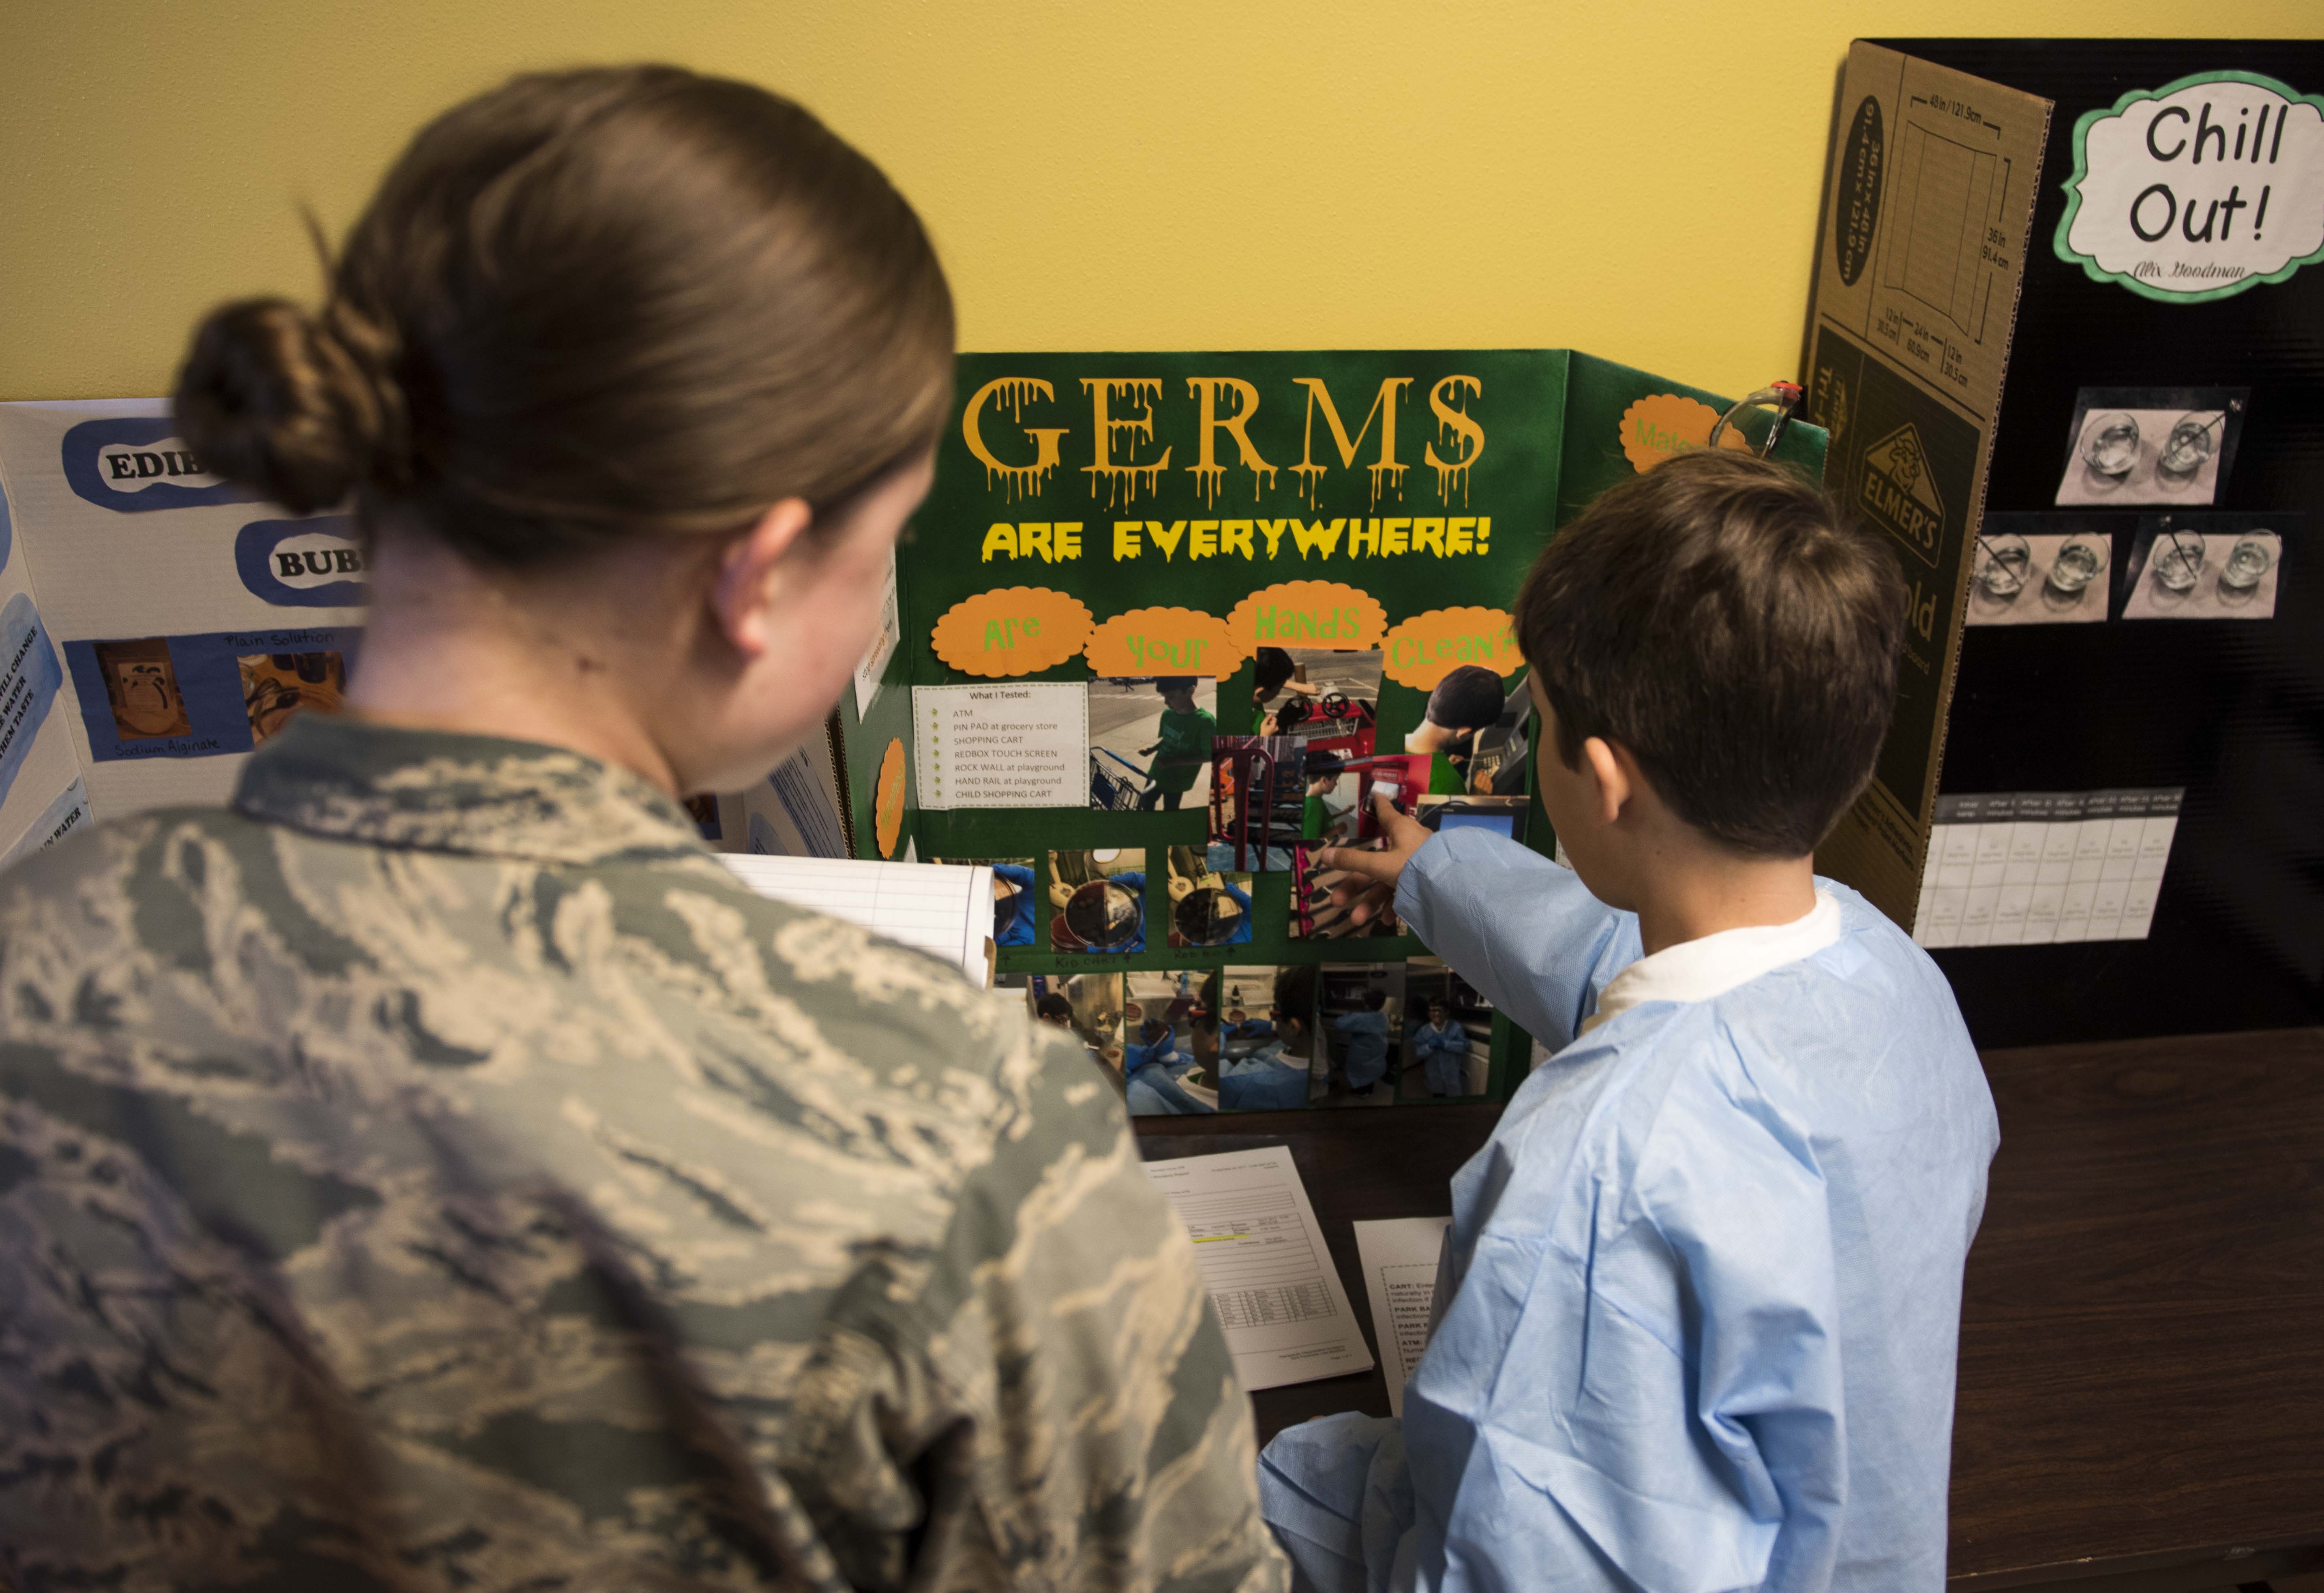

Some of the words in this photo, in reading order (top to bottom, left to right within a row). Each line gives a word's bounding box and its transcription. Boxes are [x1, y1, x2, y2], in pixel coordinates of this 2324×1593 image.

[2146, 102, 2288, 164] Chill
[2130, 183, 2270, 242] Out!
[963, 374, 1485, 515] GERMS
[1864, 472, 1937, 549] ELMER'S
[982, 522, 1084, 564] ARE
[1113, 517, 1491, 563] EVERYWHERE!
[223, 634, 265, 647] Plain
[270, 630, 334, 646] Solution
[984, 617, 1041, 652] Are
[11, 626, 38, 674] CHANGE
[3, 675, 26, 716] WATER
[13, 688, 34, 727] TASTE
[970, 691, 993, 700] What
[1000, 690, 1031, 699] Tested:
[953, 710, 973, 718] ATM
[953, 723, 968, 731] PIN
[970, 723, 989, 731] PAD
[1001, 724, 1034, 732] grocery
[115, 744, 165, 756] Sodium
[168, 738, 221, 755] Alginate
[953, 736, 999, 746] SHOPPING
[1001, 736, 1024, 744] CART
[955, 750, 989, 759] REDBOX
[992, 750, 1022, 758] TOUCH
[980, 763, 1004, 772] WALL
[1017, 763, 1065, 772] playground
[955, 777, 981, 785] HAND
[1014, 777, 1062, 786] playground
[983, 790, 1027, 798] SHOPPING
[54, 807, 81, 840] WATER
